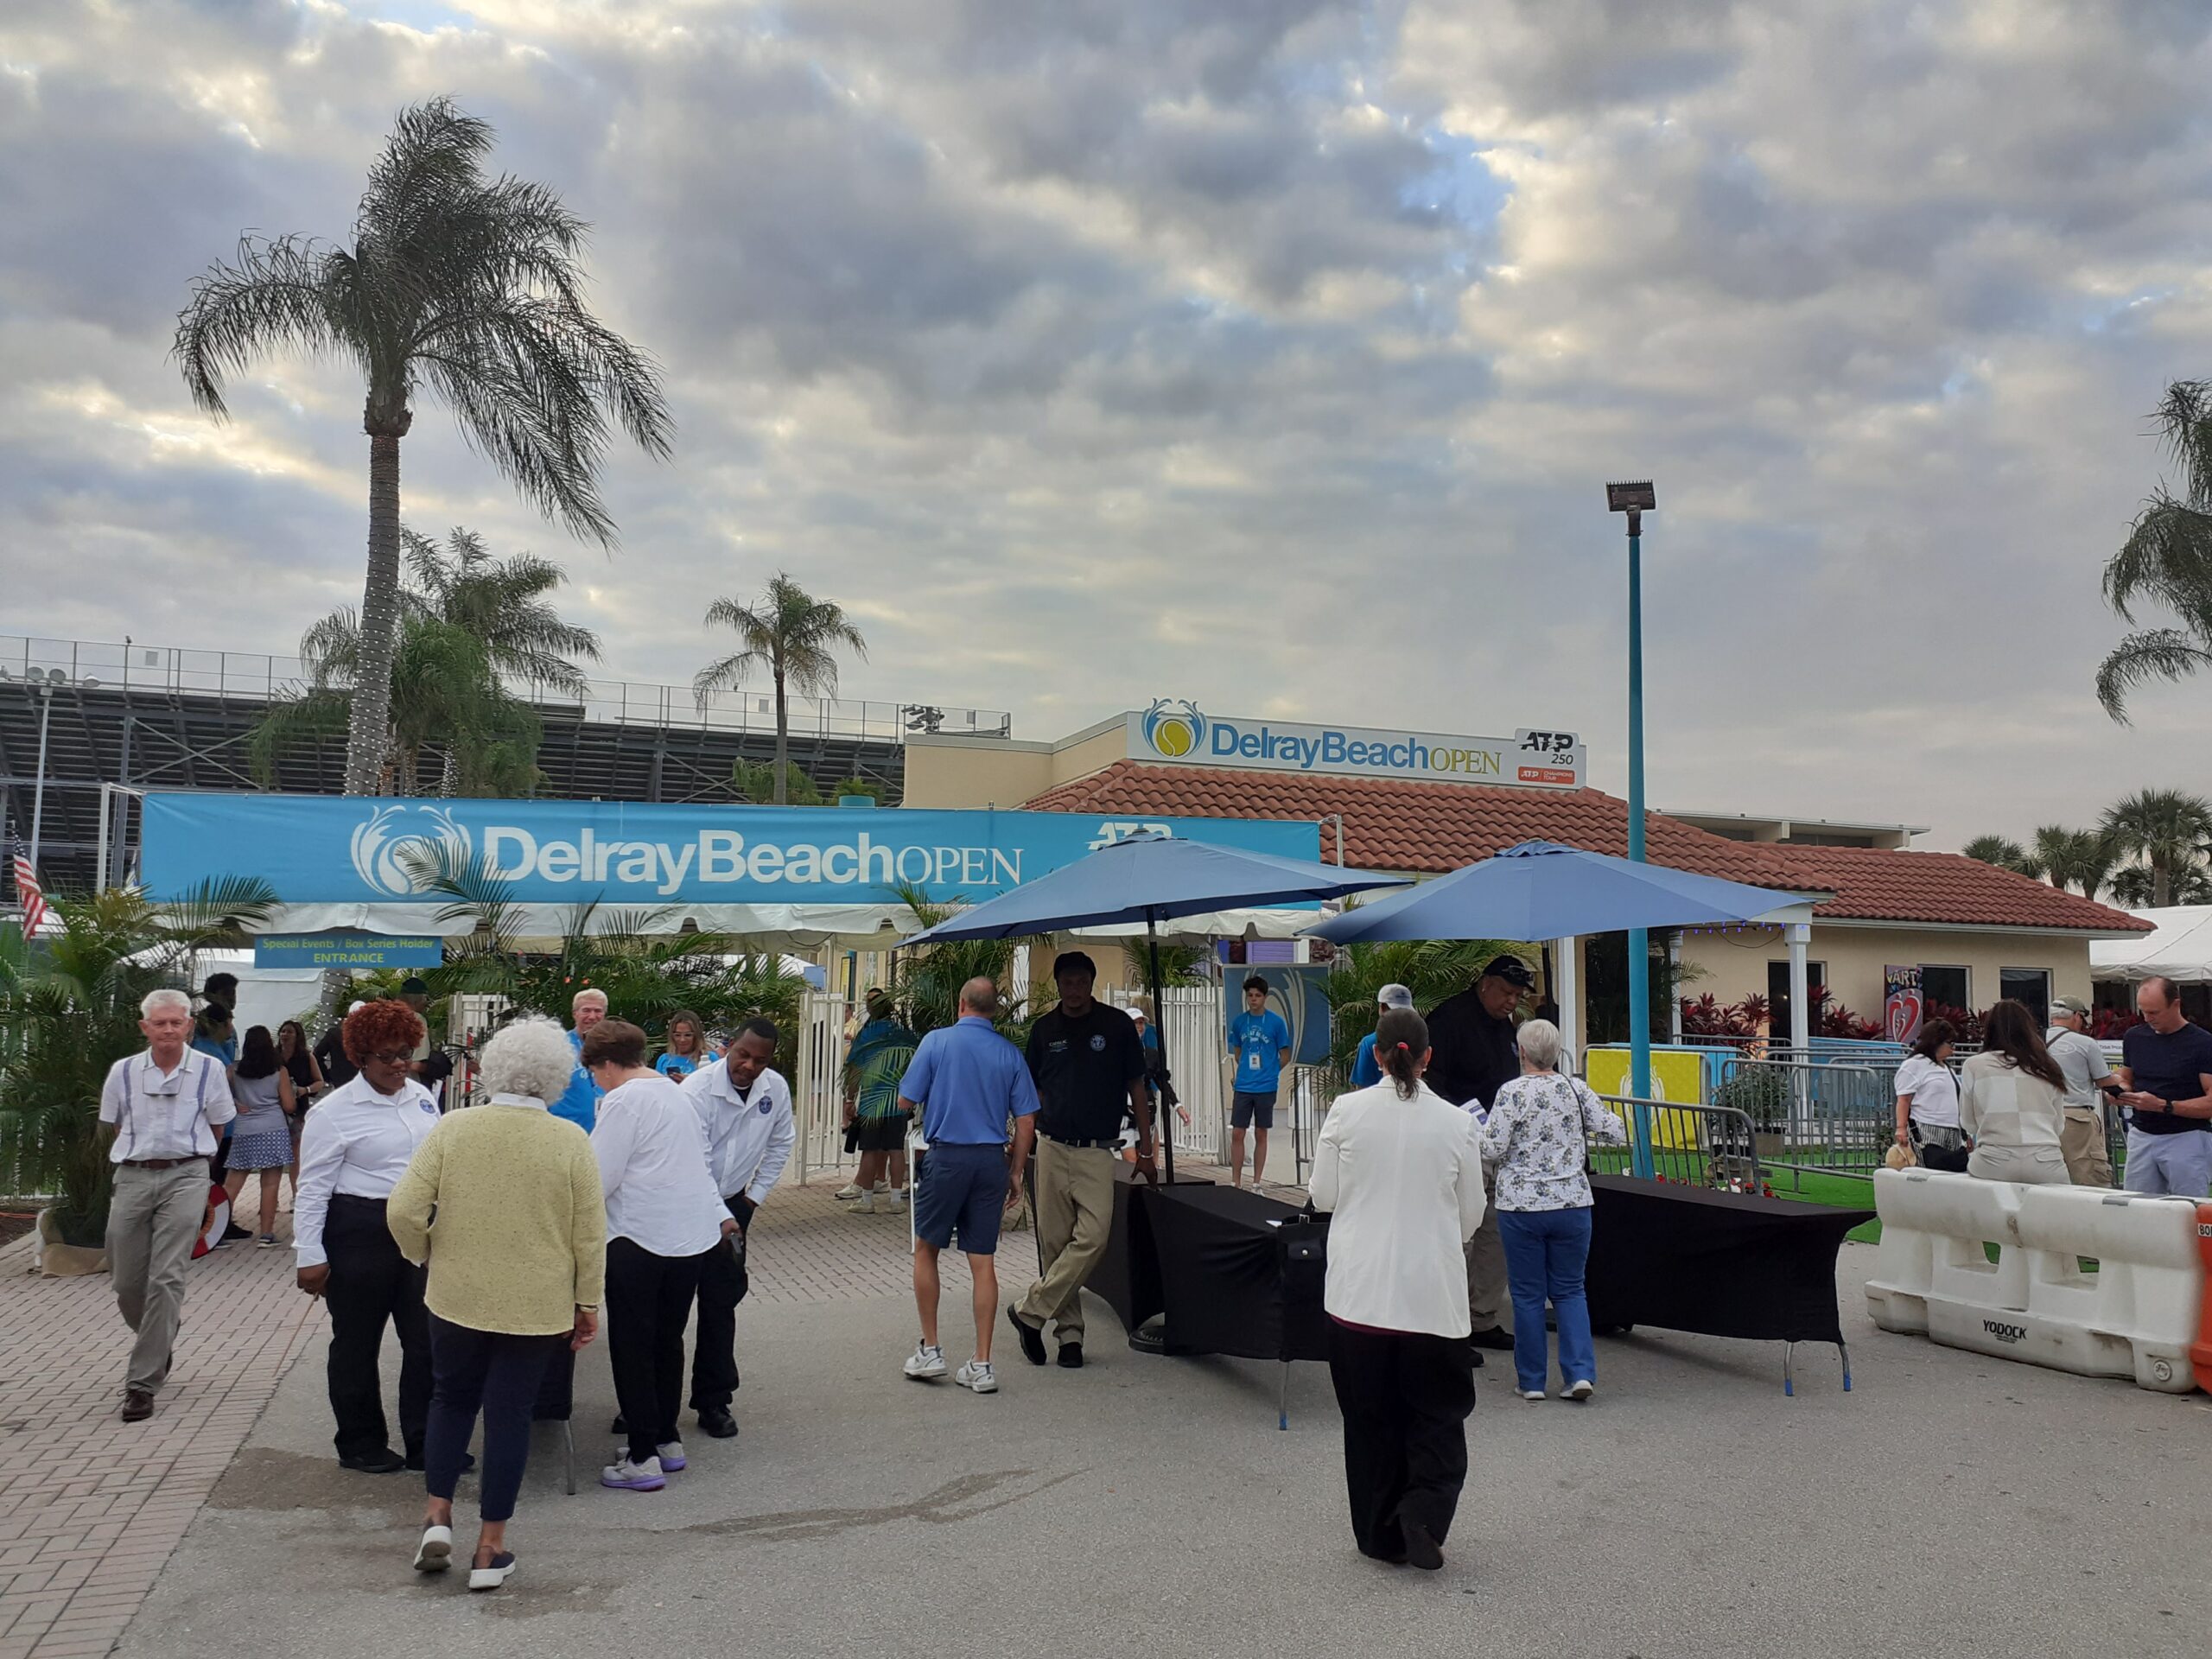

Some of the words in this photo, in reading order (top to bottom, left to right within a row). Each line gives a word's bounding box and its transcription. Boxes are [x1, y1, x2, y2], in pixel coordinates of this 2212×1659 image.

[1519, 731, 1573, 753] ATP
[1551, 753, 1573, 765] 250
[263, 938, 299, 950] Special
[302, 938, 335, 948] Events
[346, 938, 364, 948] Box
[367, 938, 397, 948] Series
[399, 938, 435, 948] Holder
[313, 953, 385, 963] ENTRANCE
[1983, 1319, 2027, 1340] YODOCK
